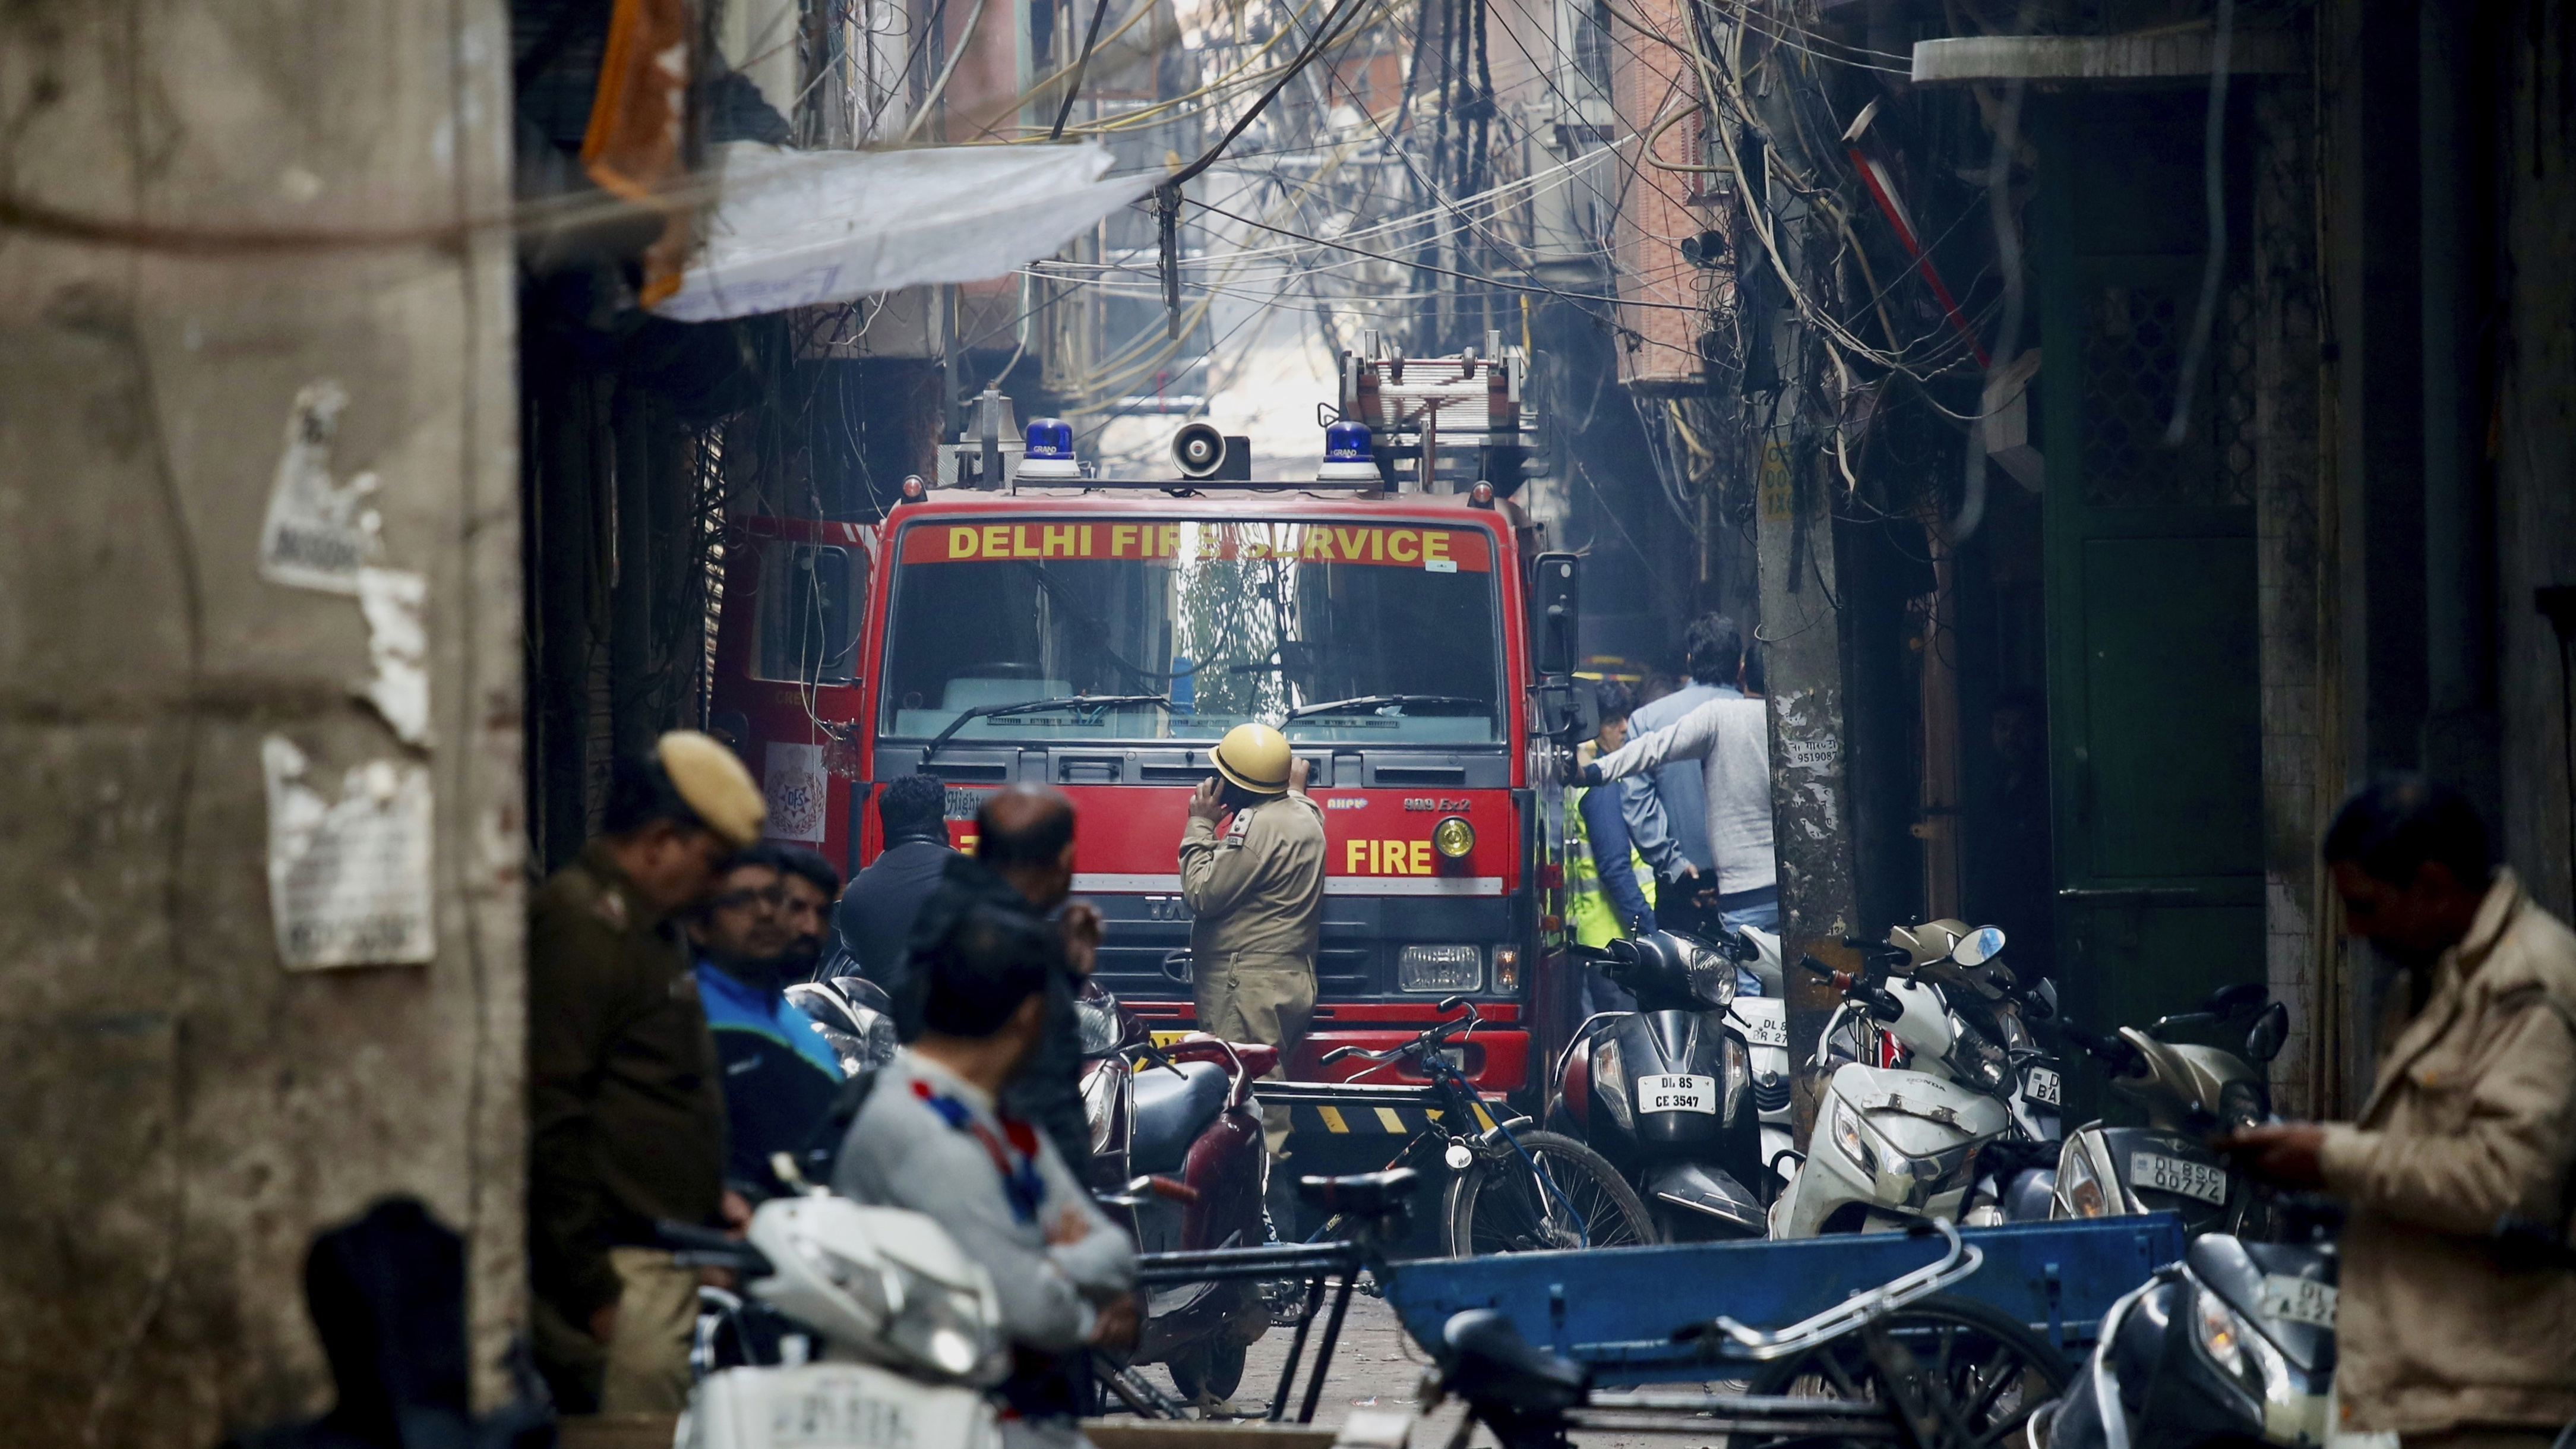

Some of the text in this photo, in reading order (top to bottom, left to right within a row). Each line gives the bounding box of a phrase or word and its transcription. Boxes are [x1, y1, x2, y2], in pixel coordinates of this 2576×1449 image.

[949, 525, 1092, 558] DELHI
[1111, 525, 1221, 557] FIRE
[1798, 752, 1837, 762] 9519087
[1347, 839, 1431, 875] FIRE
[1763, 1019, 1777, 1030] DL
[1662, 1077, 1693, 1088] DL 8S
[1905, 1078, 1946, 1092] HONDA
[1656, 1095, 1699, 1108] CE 3547
